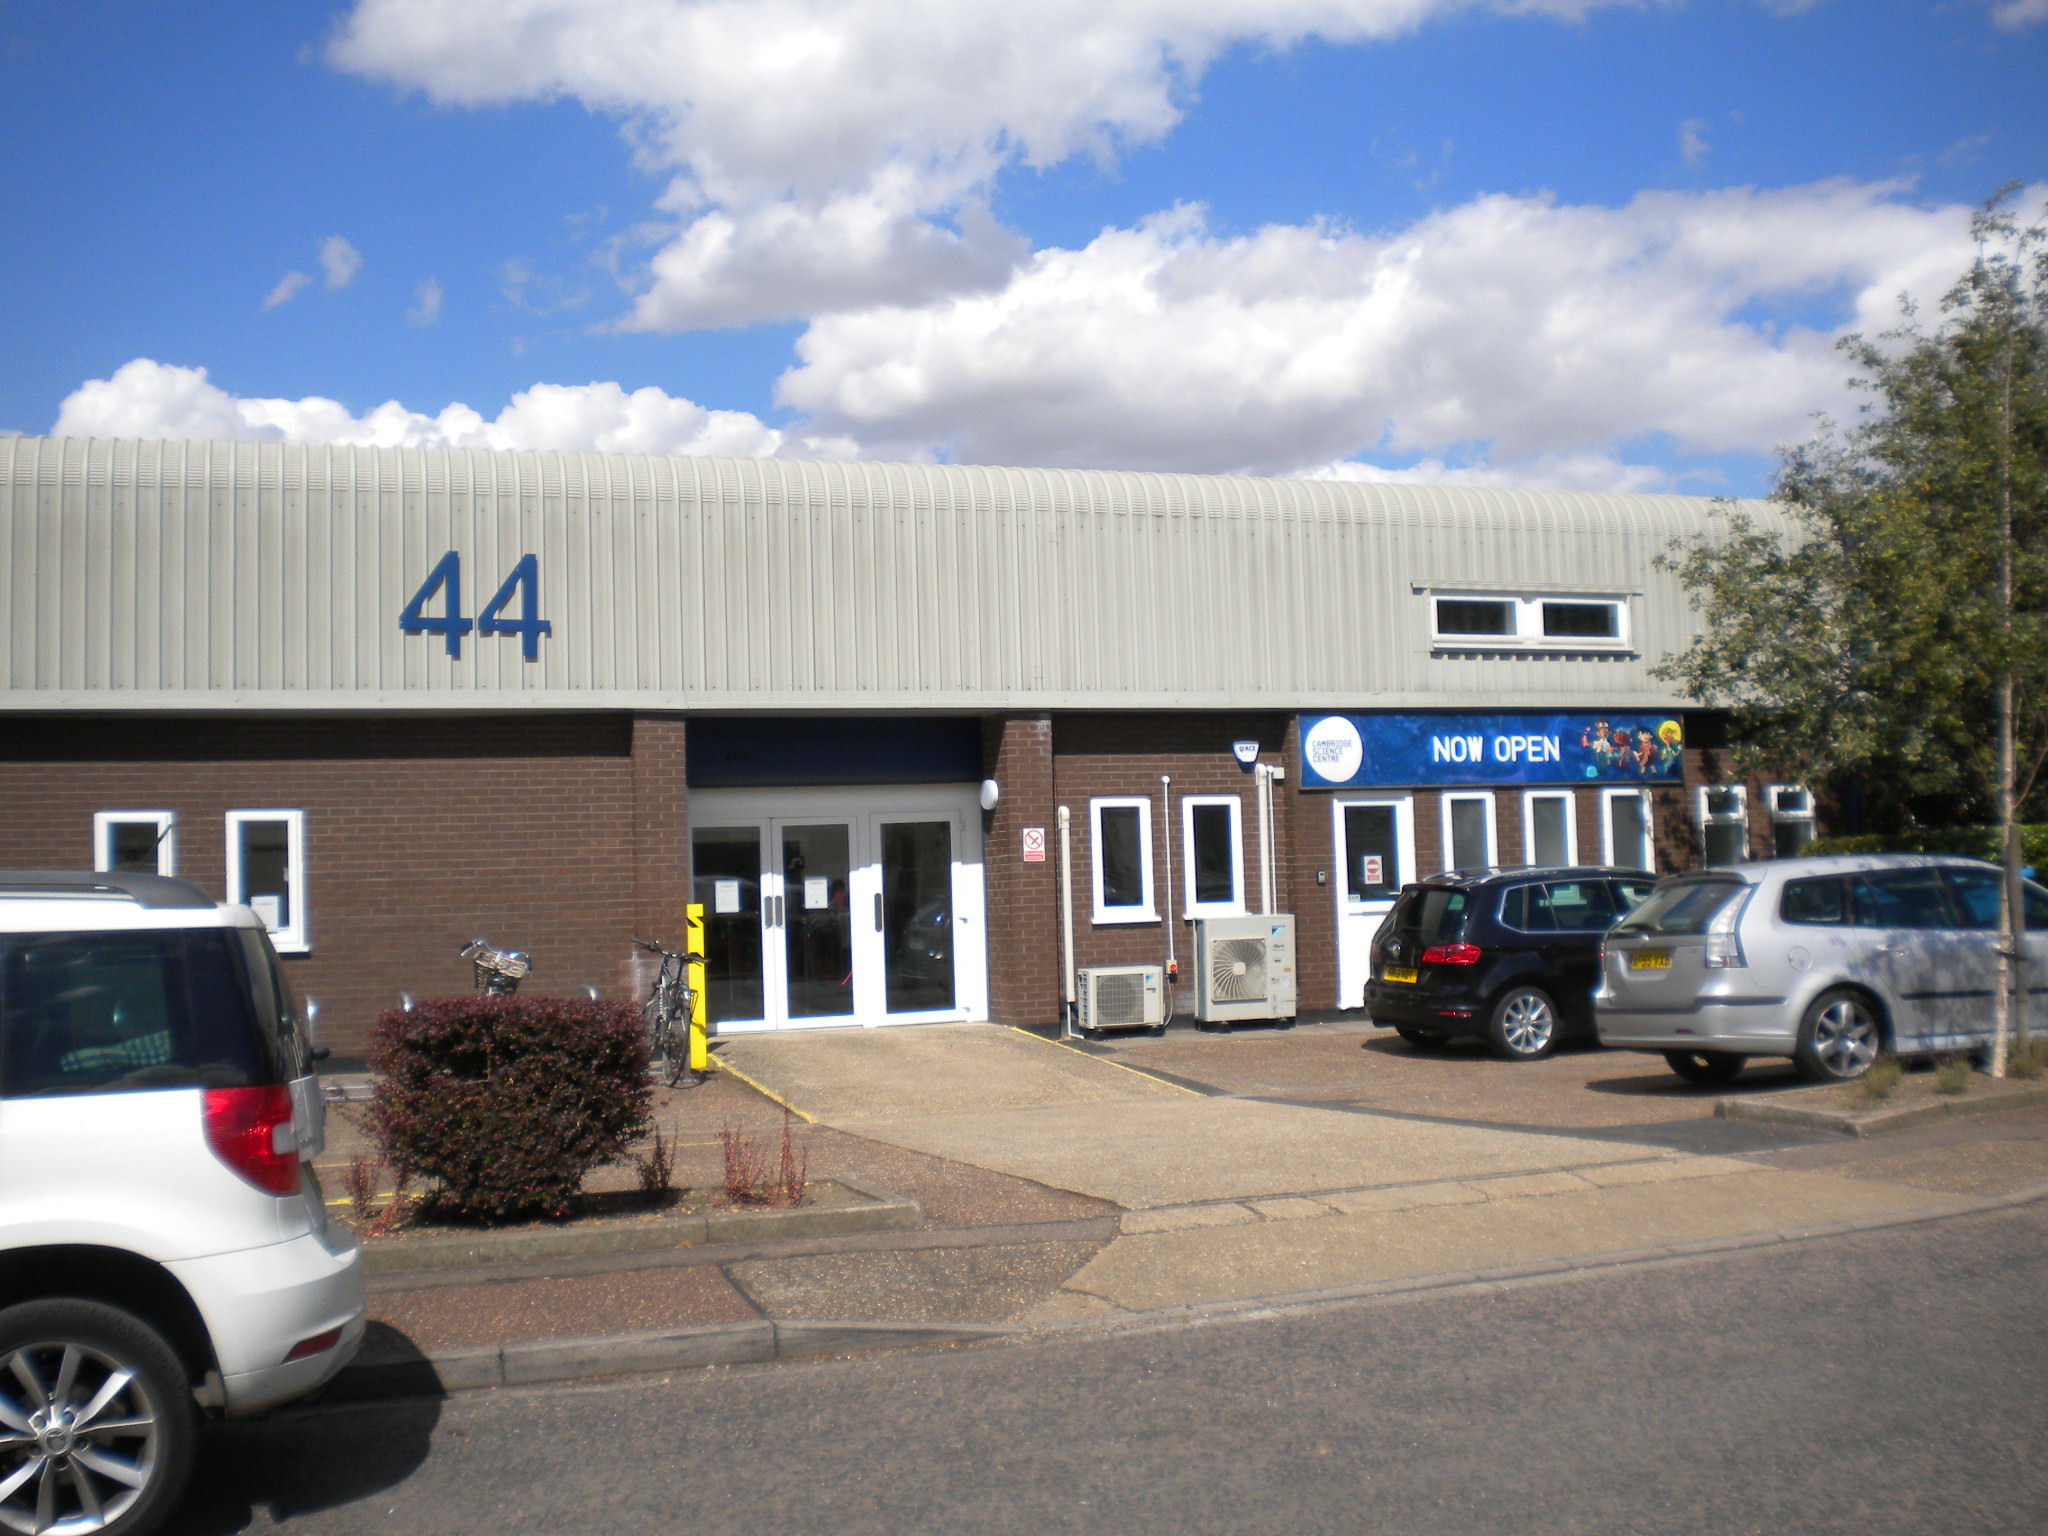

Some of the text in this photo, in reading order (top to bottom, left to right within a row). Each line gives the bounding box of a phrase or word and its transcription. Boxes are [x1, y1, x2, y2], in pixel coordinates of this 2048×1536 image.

[399, 550, 551, 660] 44
[1311, 739, 1353, 748] CAMBRIDGE
[1312, 747, 1344, 755] SCIENCE
[1433, 735, 1560, 762] NOW OPEN
[1312, 755, 1340, 763] CENTRE
